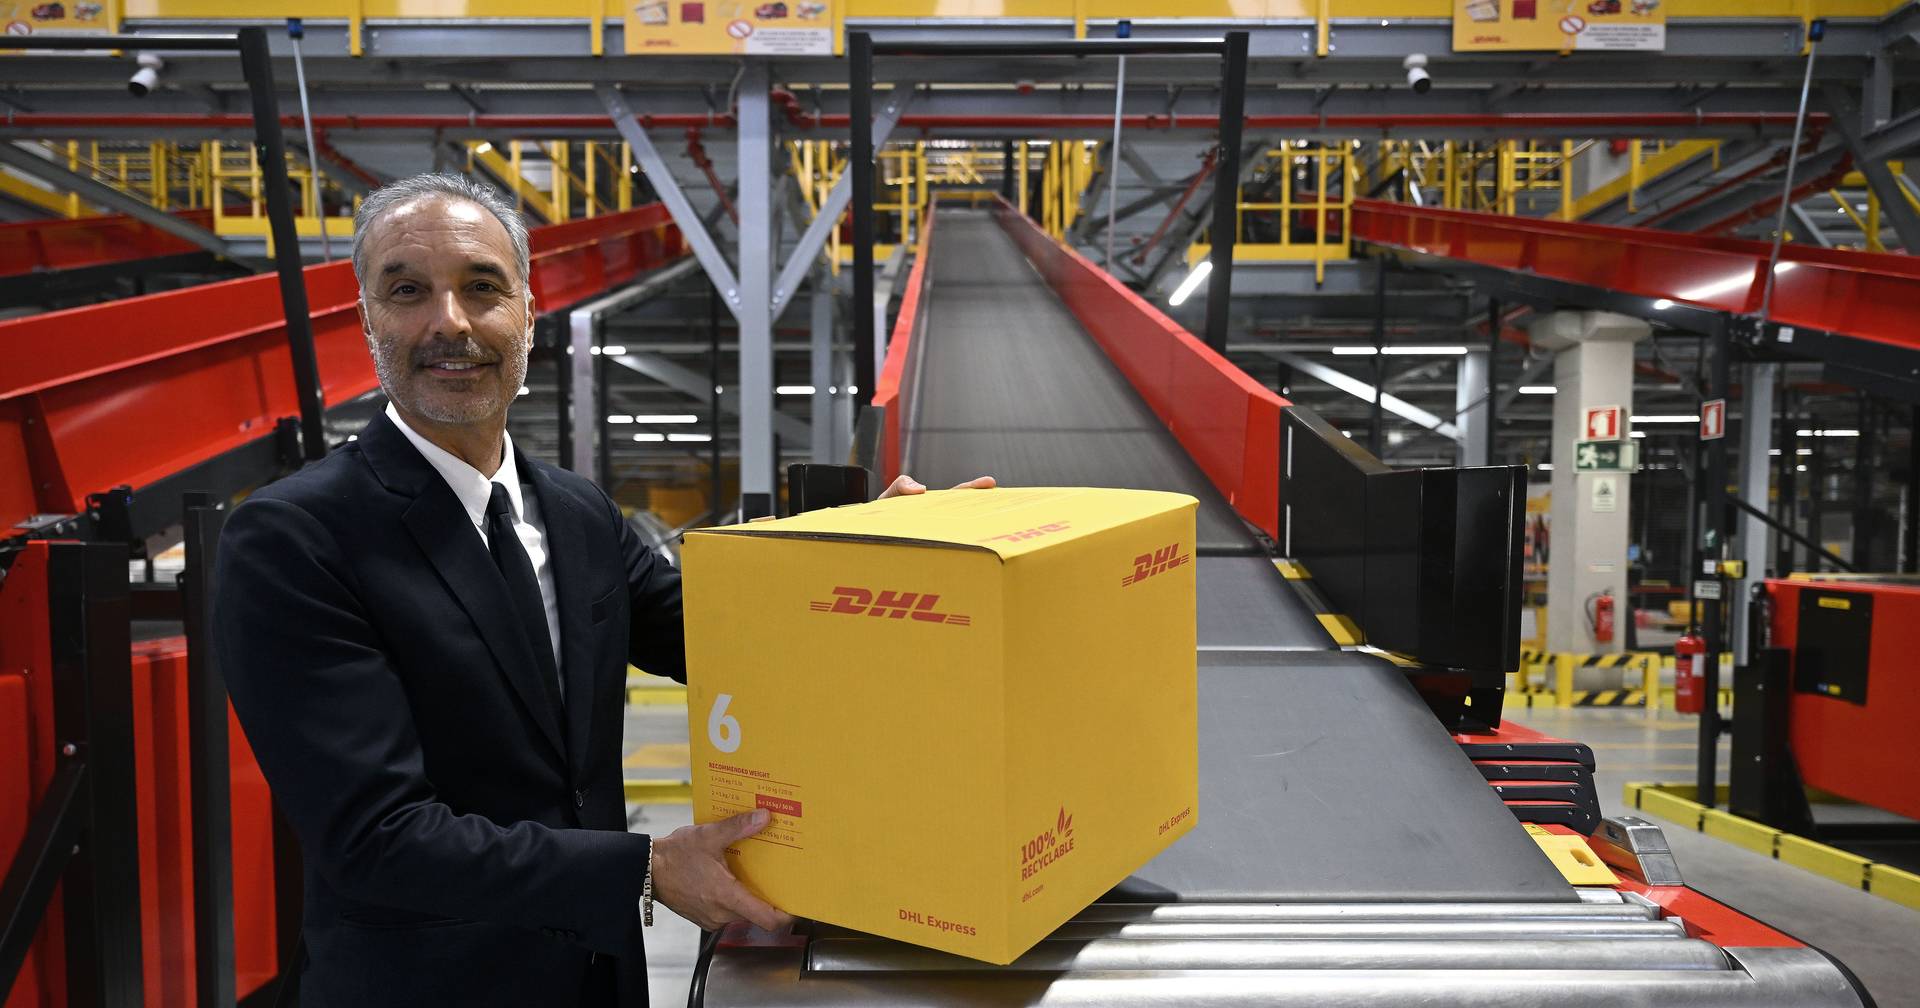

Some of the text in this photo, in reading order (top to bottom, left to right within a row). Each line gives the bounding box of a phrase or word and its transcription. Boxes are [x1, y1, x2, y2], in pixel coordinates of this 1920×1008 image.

[1133, 543, 1181, 583] DHL
[831, 586, 948, 623] DHL
[707, 693, 742, 753] 6
[709, 762, 770, 779] RECOMMENDED WEIGHT
[1159, 808, 1190, 835] DHL Express
[1021, 827, 1056, 865] 100%
[1021, 838, 1074, 881] RECYCLABLE
[1022, 884, 1044, 903] dhl.com
[899, 909, 976, 936] DHL Express
